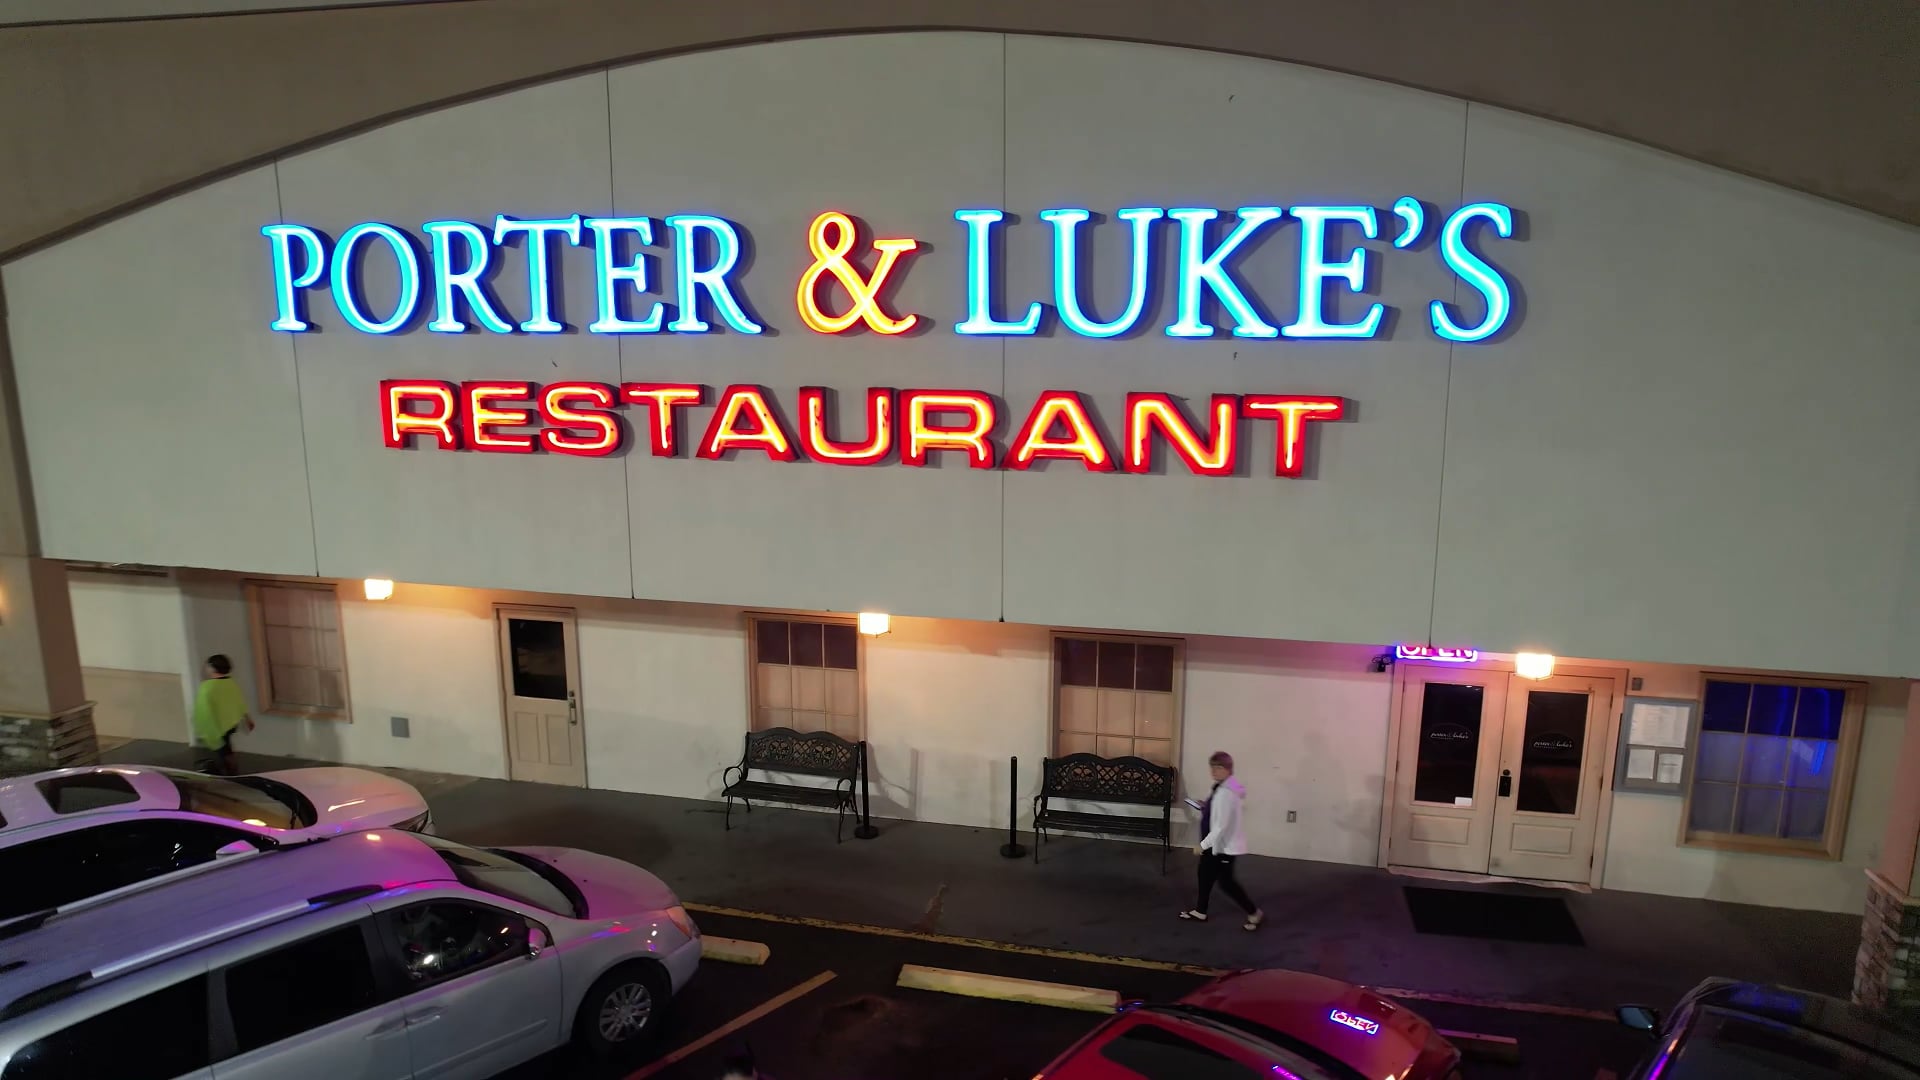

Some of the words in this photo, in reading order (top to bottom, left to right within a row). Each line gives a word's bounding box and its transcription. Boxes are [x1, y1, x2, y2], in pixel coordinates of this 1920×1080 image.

[261, 213, 762, 335] PORTER
[796, 210, 918, 335] &
[954, 196, 1514, 342] LUKE'S
[380, 379, 1344, 478] RESTAURANT
